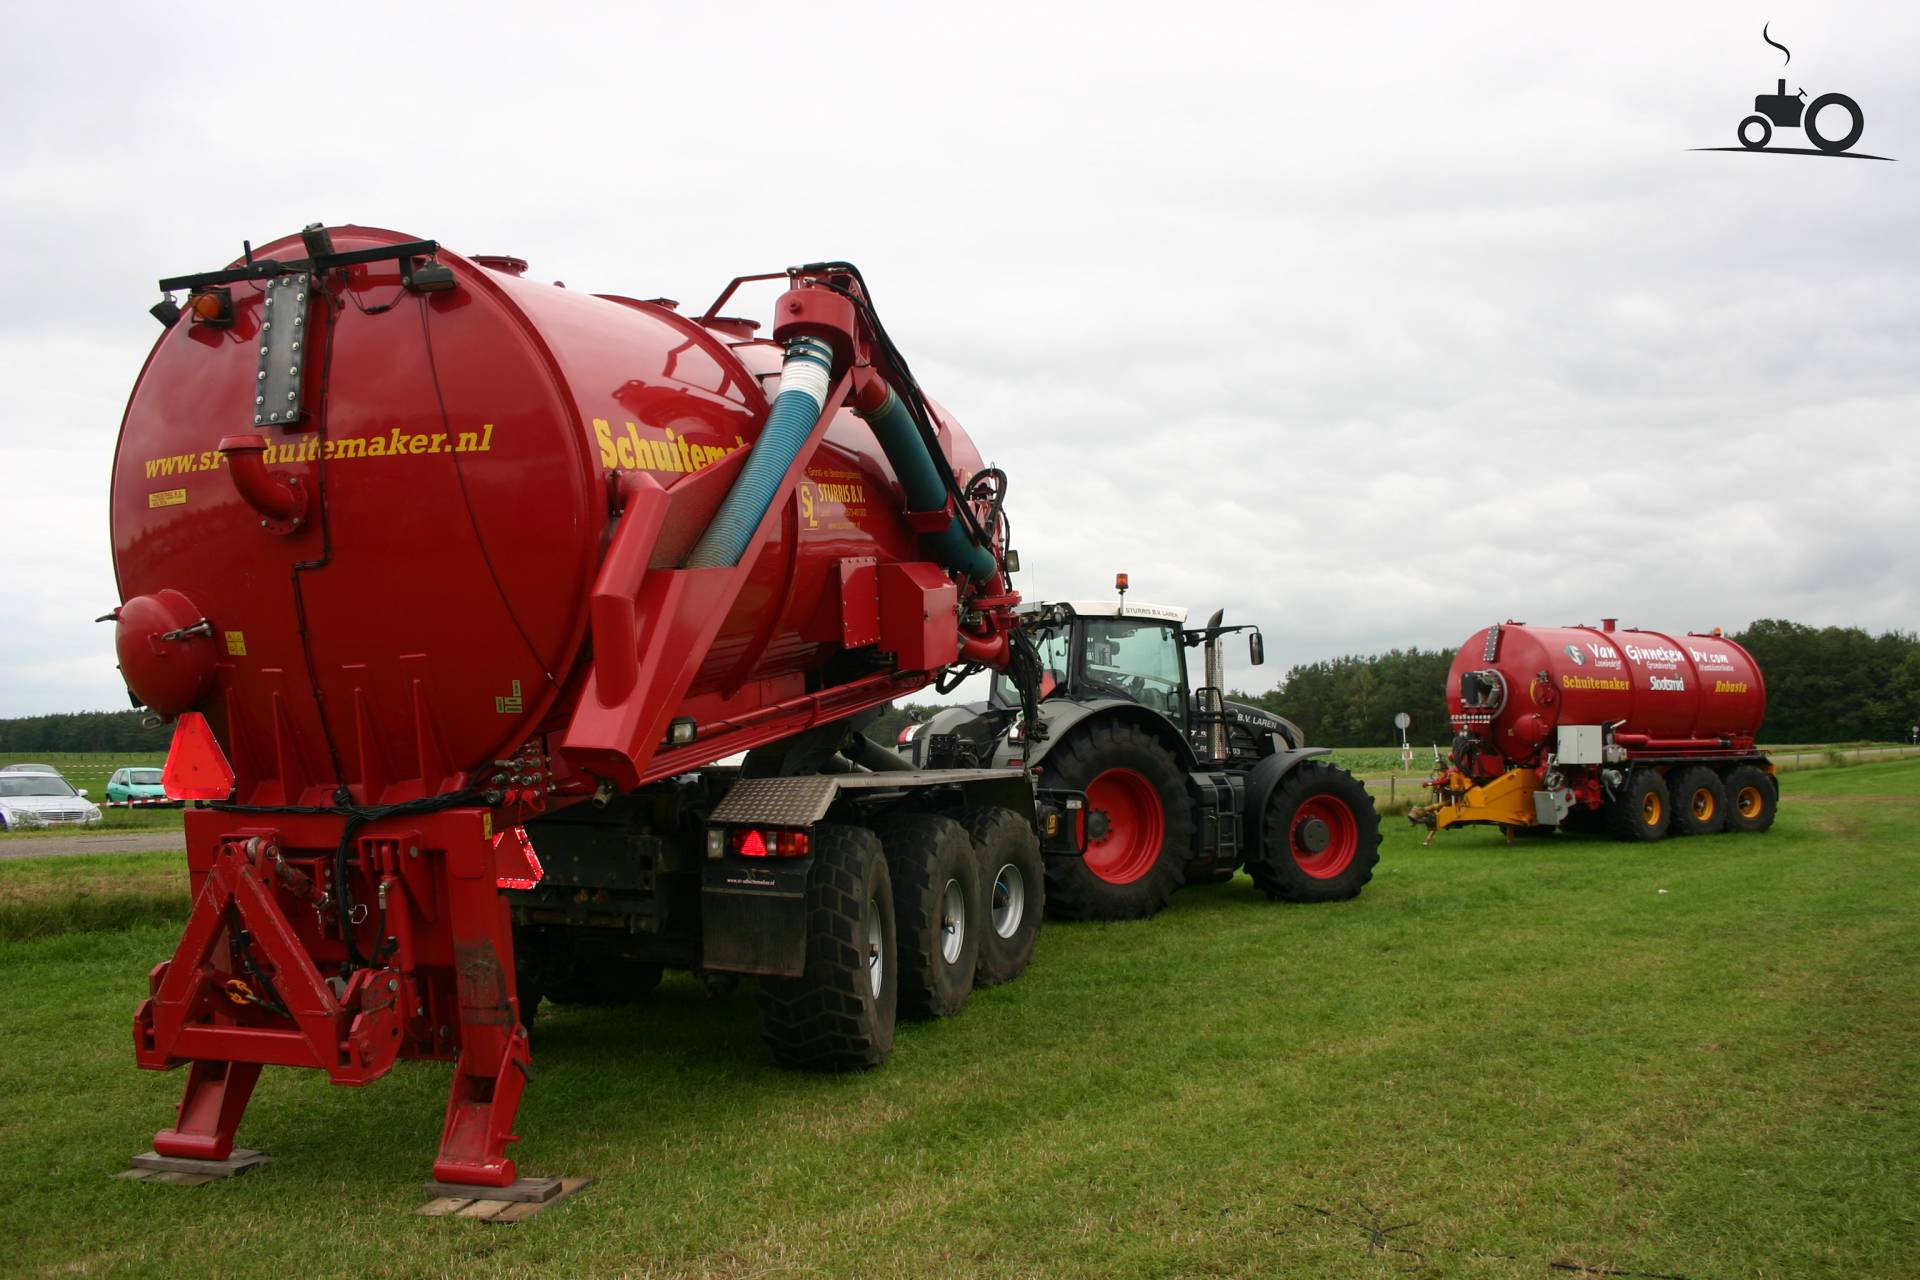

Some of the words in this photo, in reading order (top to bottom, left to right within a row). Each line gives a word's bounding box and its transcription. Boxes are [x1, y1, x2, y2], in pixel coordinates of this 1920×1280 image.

[145, 424, 494, 479] www.srhuitemaker.nl
[818, 483, 851, 503] STURRIS
[850, 485, 866, 503] B.V.
[1126, 607, 1151, 615] STURRIS
[1586, 643, 1616, 658] Van
[1625, 644, 1684, 664] Ginneken
[1562, 674, 1630, 690] Schuitemaker
[1237, 713, 1251, 724] B.V.
[1253, 716, 1278, 730] LAREN
